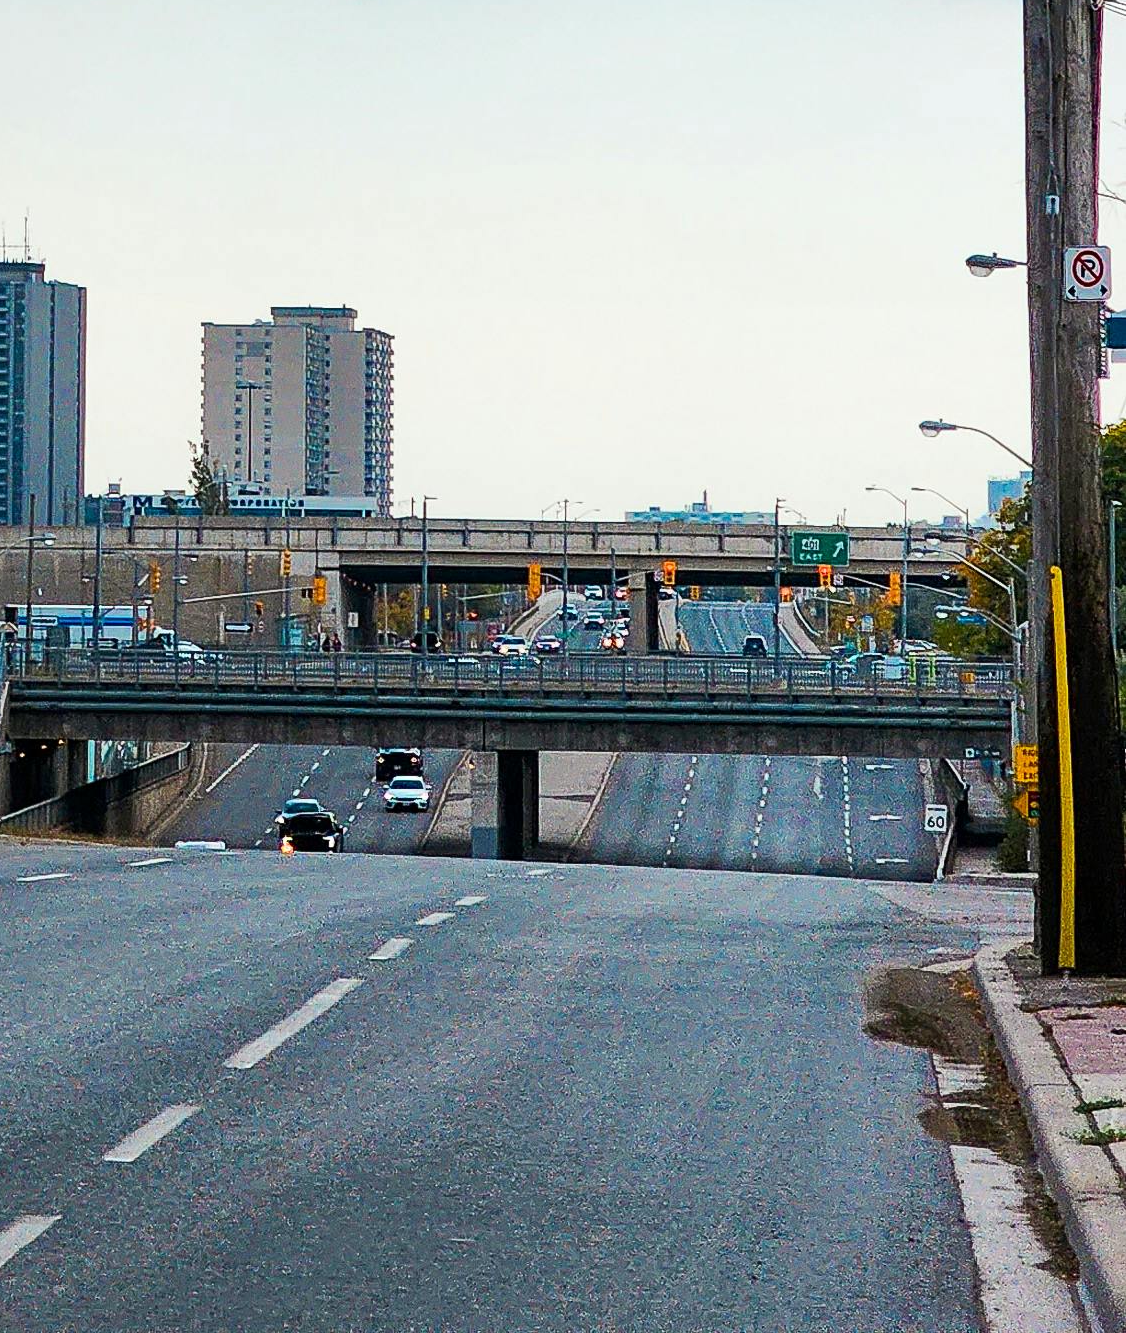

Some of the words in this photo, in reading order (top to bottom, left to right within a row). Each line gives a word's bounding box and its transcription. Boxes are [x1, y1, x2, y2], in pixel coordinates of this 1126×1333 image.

[230, 498, 305, 507] ORPORATION
[803, 540, 818, 550] 401
[927, 816, 945, 828] 60
